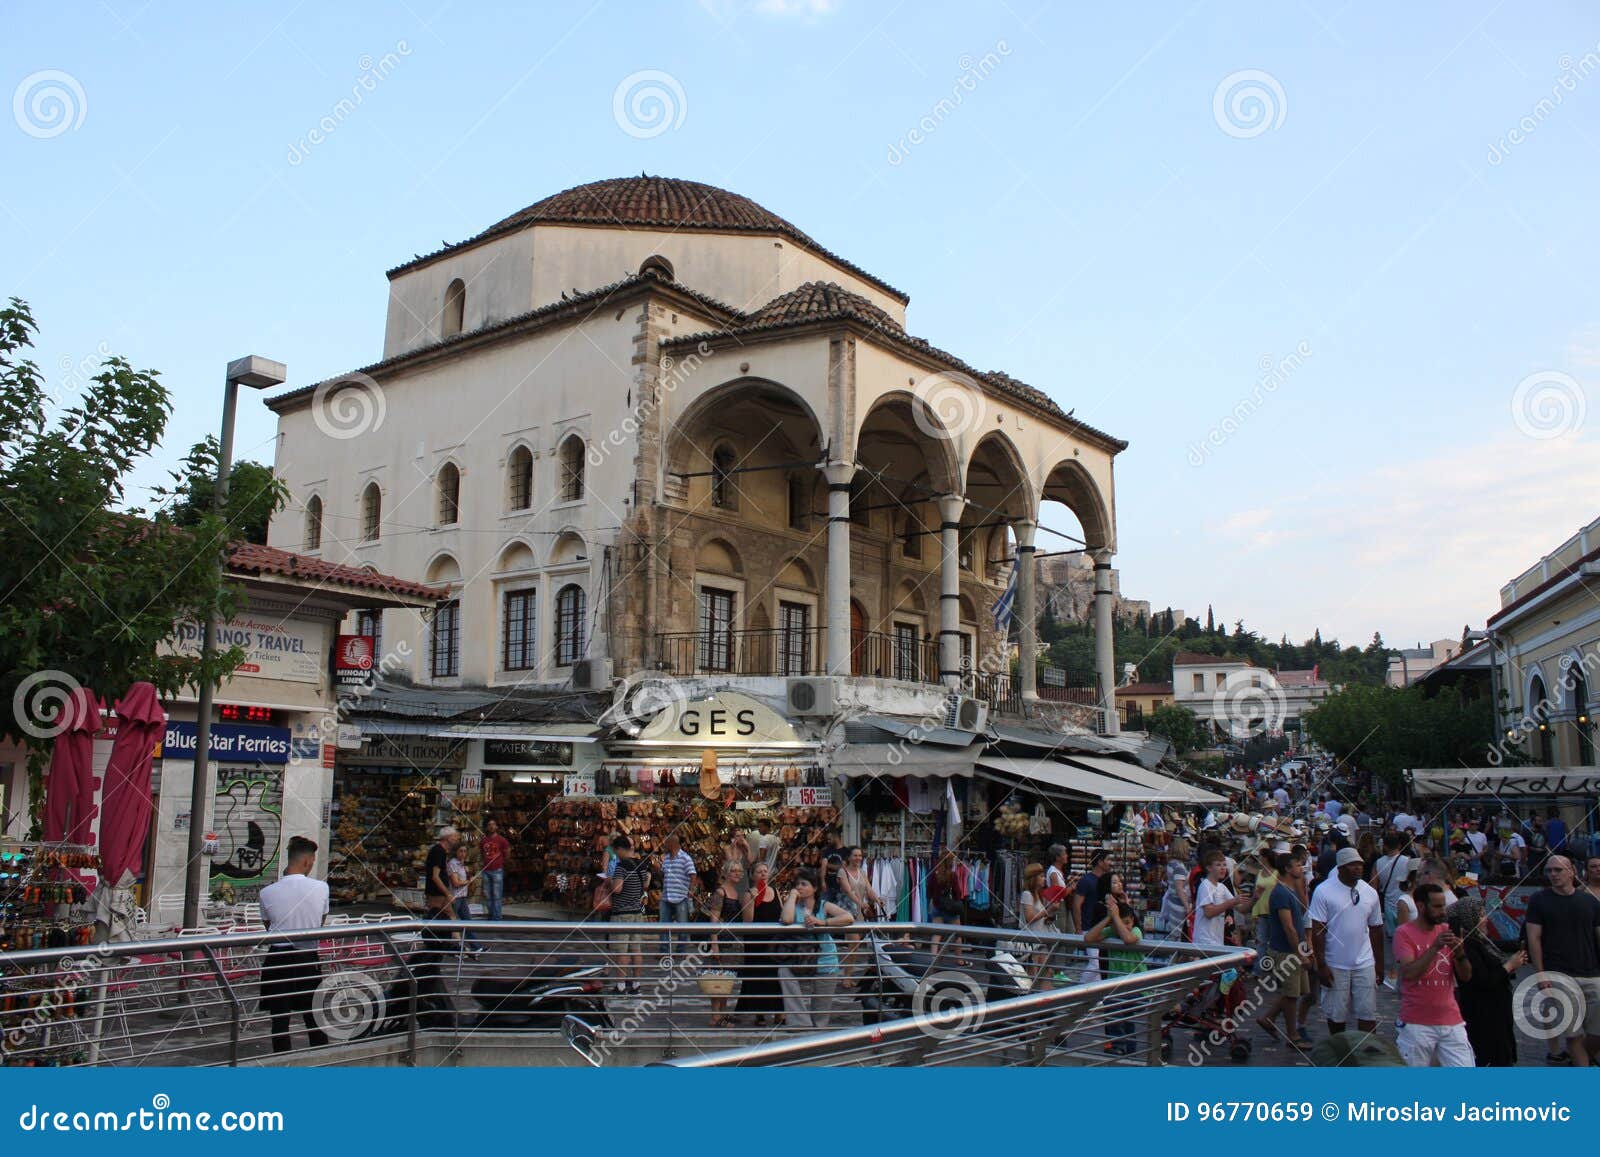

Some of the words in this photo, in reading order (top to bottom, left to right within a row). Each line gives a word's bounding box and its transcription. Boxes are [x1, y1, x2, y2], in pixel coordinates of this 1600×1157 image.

[257, 632, 306, 654] TRAVEL
[255, 651, 281, 662] Tickets
[336, 669, 371, 677] MINOAN
[165, 730, 197, 749] Blue
[237, 735, 286, 753] Ferries
